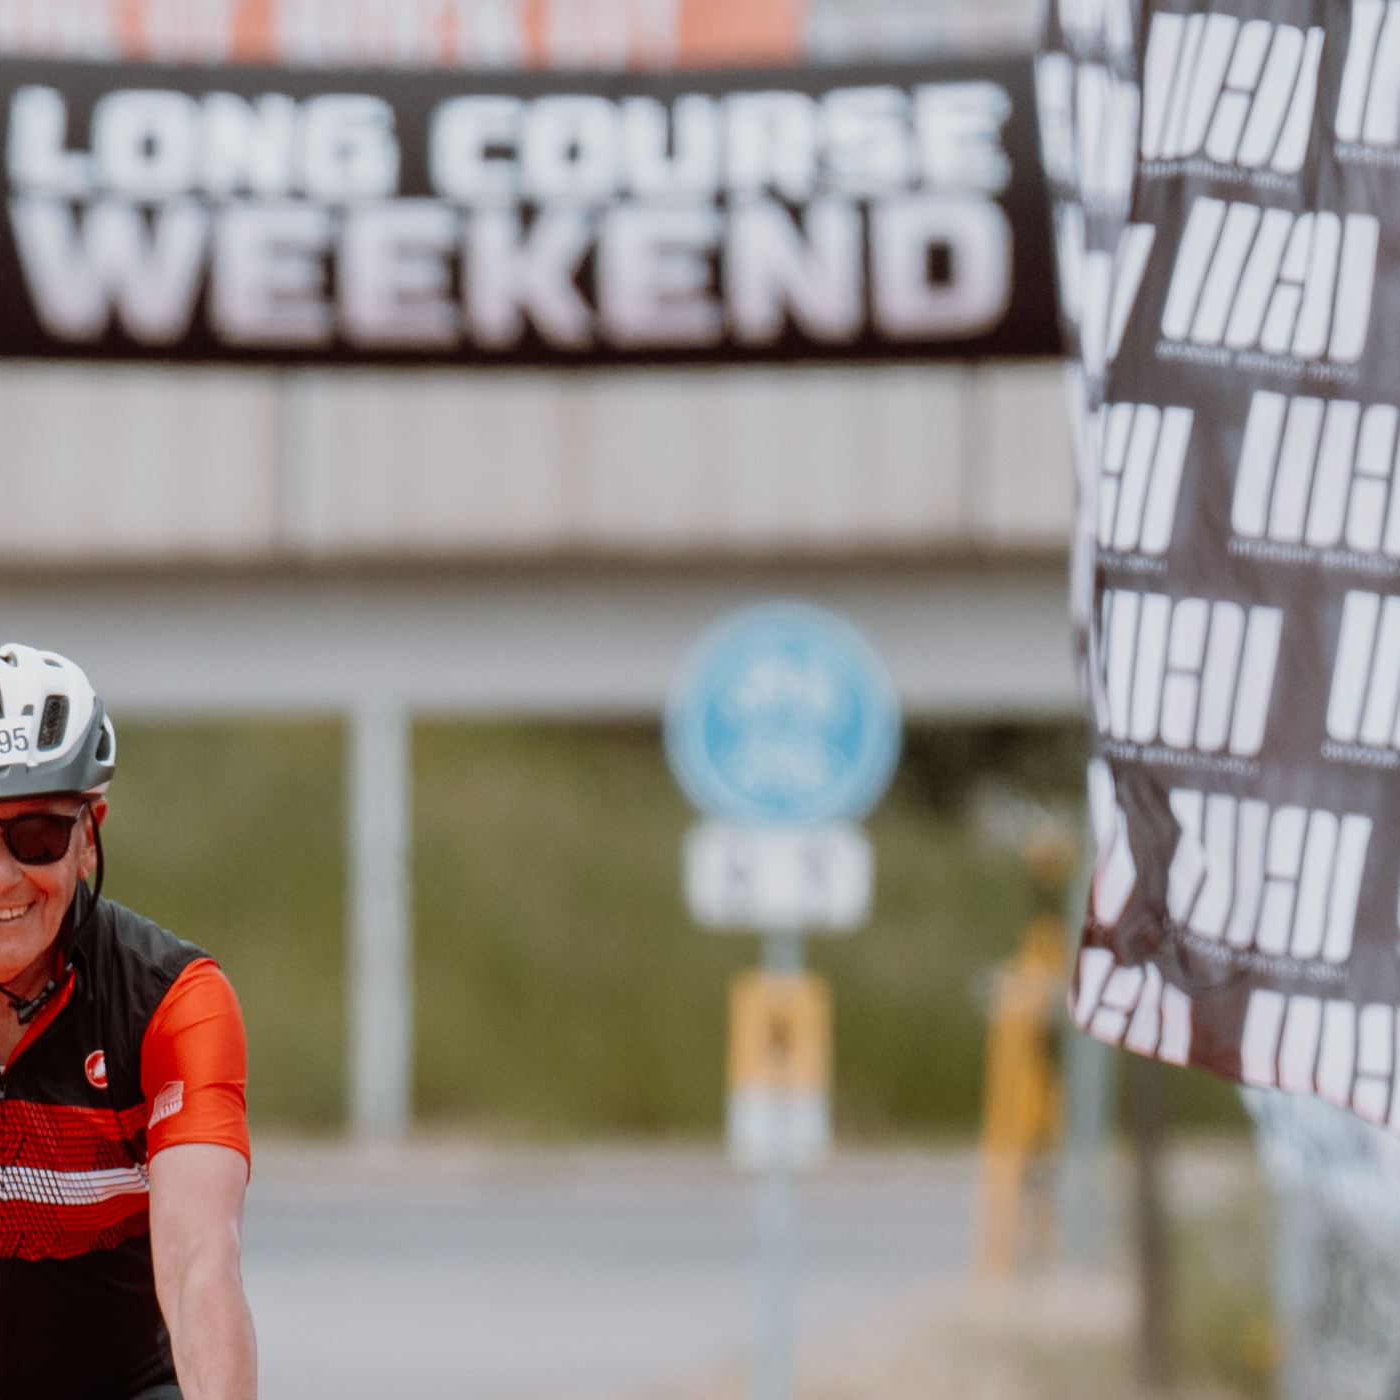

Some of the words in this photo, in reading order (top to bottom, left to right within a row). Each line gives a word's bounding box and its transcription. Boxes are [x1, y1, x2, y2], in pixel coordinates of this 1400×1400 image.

[5, 84, 399, 195] LONG
[429, 80, 1014, 202] COURSE
[7, 192, 1015, 350] WEEKEND
